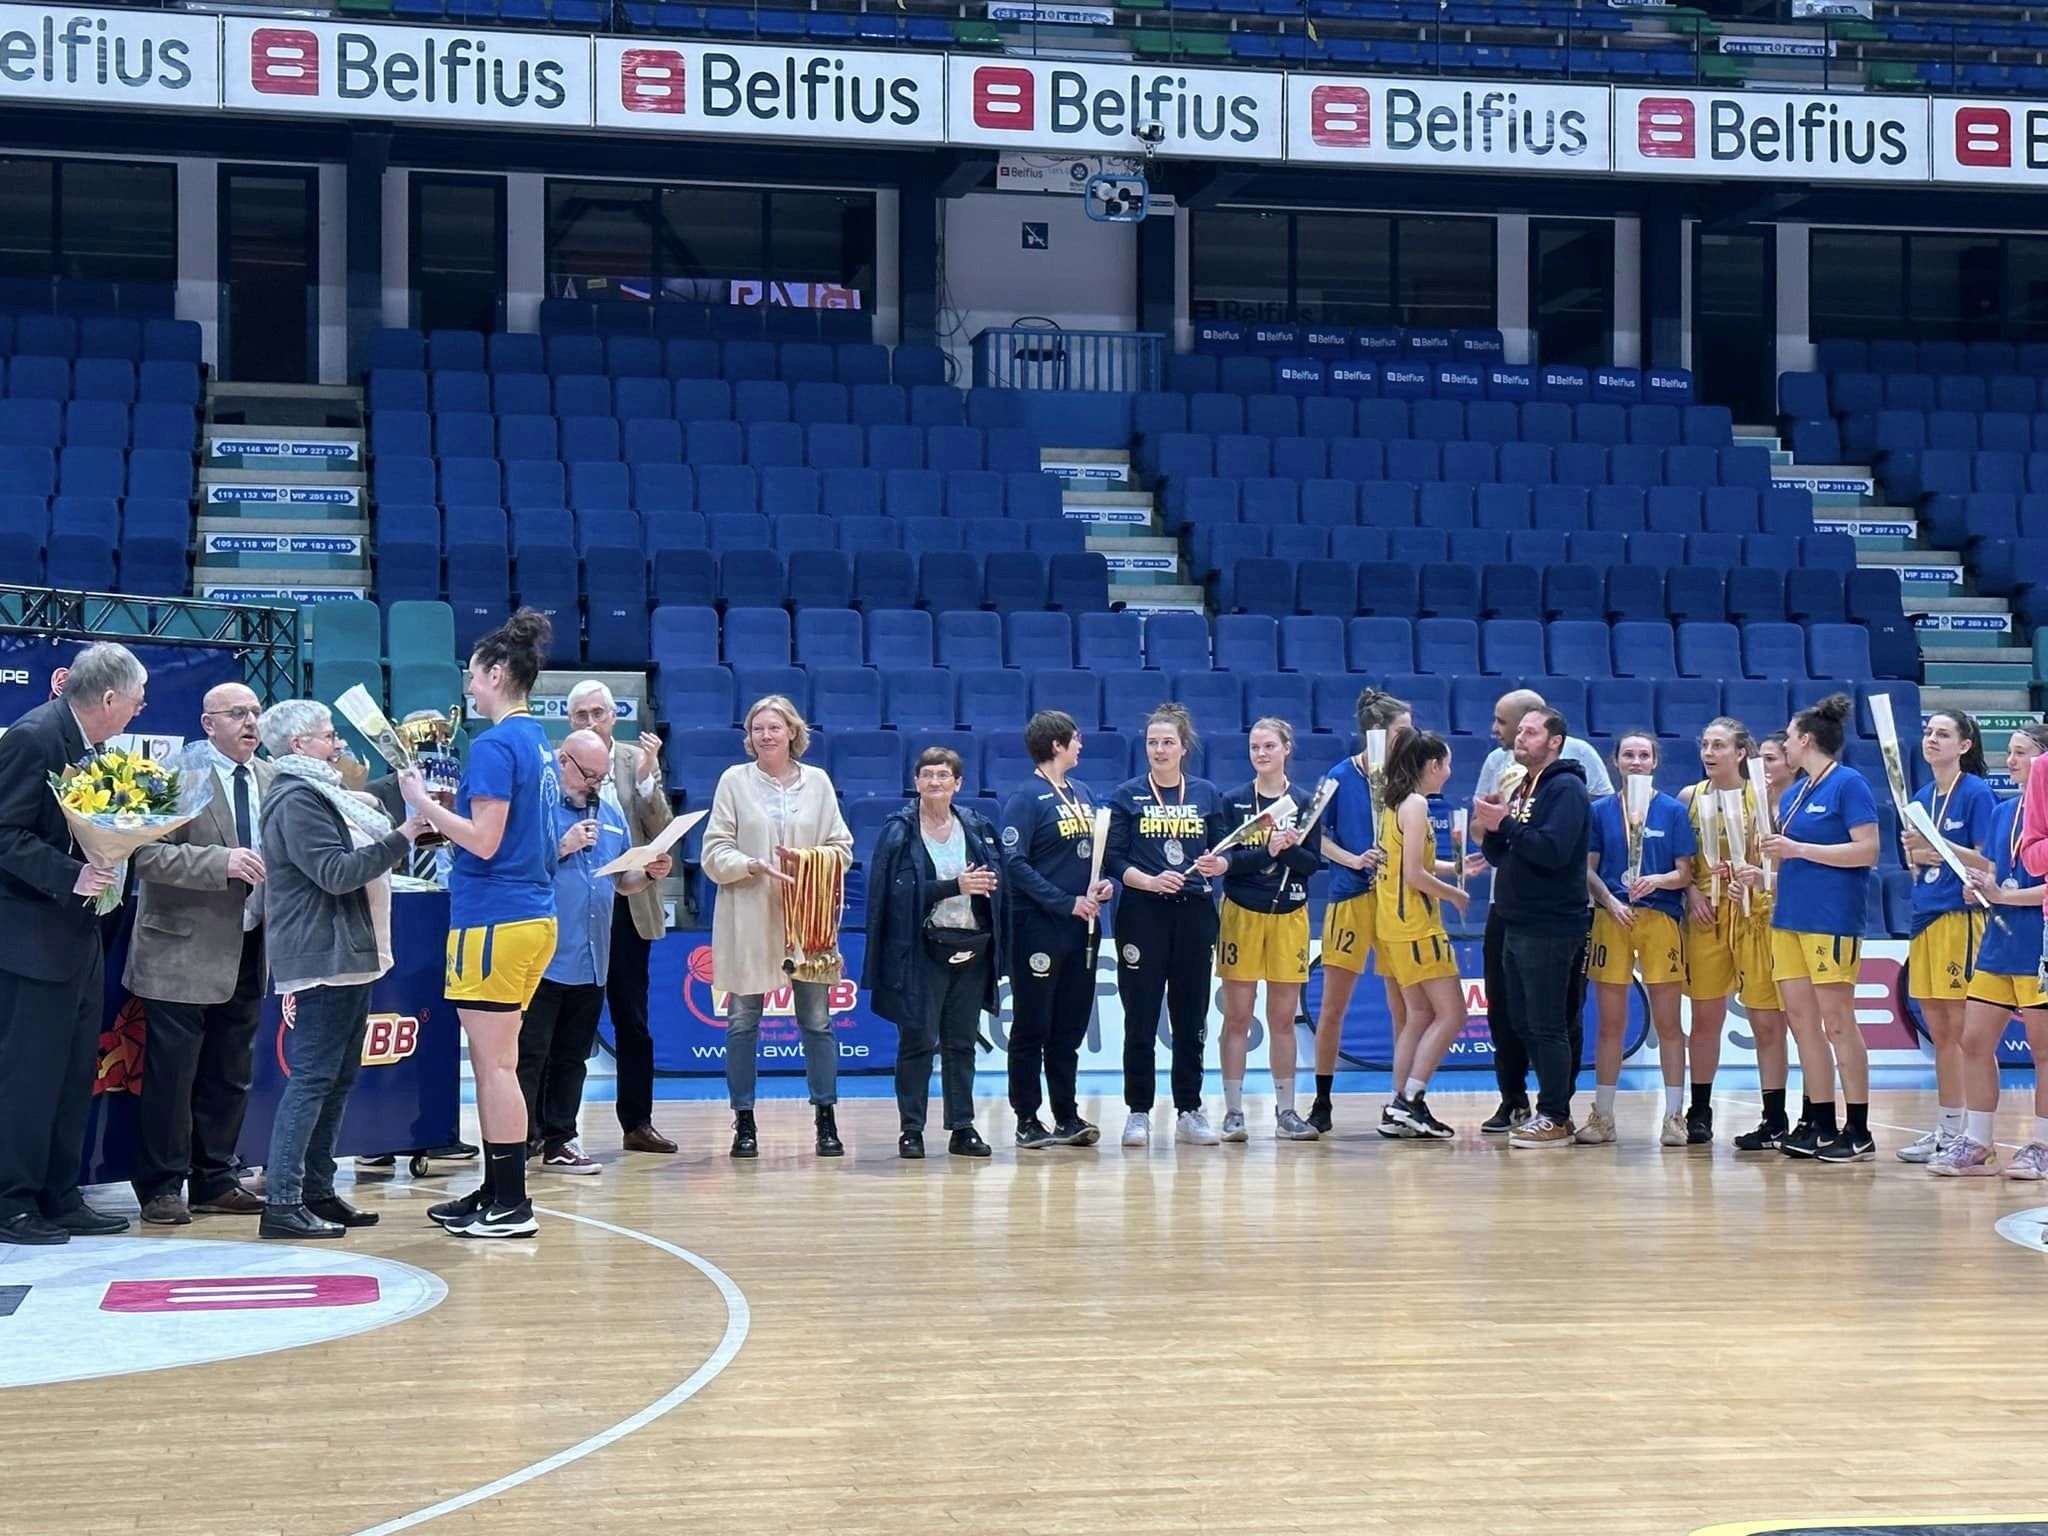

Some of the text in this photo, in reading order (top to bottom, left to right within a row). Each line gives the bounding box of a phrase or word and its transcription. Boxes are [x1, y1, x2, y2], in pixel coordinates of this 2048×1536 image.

[0, 16, 192, 89] elfius
[336, 33, 566, 109] Belfius
[702, 53, 920, 126] Belfius
[1051, 70, 1259, 142] Belfius
[1386, 87, 1589, 158] Belfius
[1710, 99, 1908, 166] Belfius
[1011, 167, 1043, 179] Belfius
[1212, 330, 1239, 340] Belfius
[1266, 332, 1293, 342] Belfius
[1317, 334, 1344, 345] Belfius
[1370, 337, 1396, 347] Belfius
[1421, 337, 1448, 347] Belfius
[1291, 369, 1319, 381] Belfius
[1343, 370, 1371, 381] Belfius
[1396, 372, 1424, 383] Belfius
[1451, 373, 1478, 385] Belfius
[1502, 375, 1529, 386] Belfius
[1556, 375, 1583, 386] Belfius
[1608, 376, 1635, 388] Belfius
[1660, 378, 1687, 389] Belfius
[264, 446, 279, 454] VIP
[1860, 526, 1873, 534] VIP
[262, 541, 276, 549] VIP
[530, 704, 545, 712] VIP
[1335, 928, 1356, 954] 12
[1221, 941, 1238, 965] 13
[1591, 943, 1608, 968] 10
[366, 1017, 419, 1058] BB
